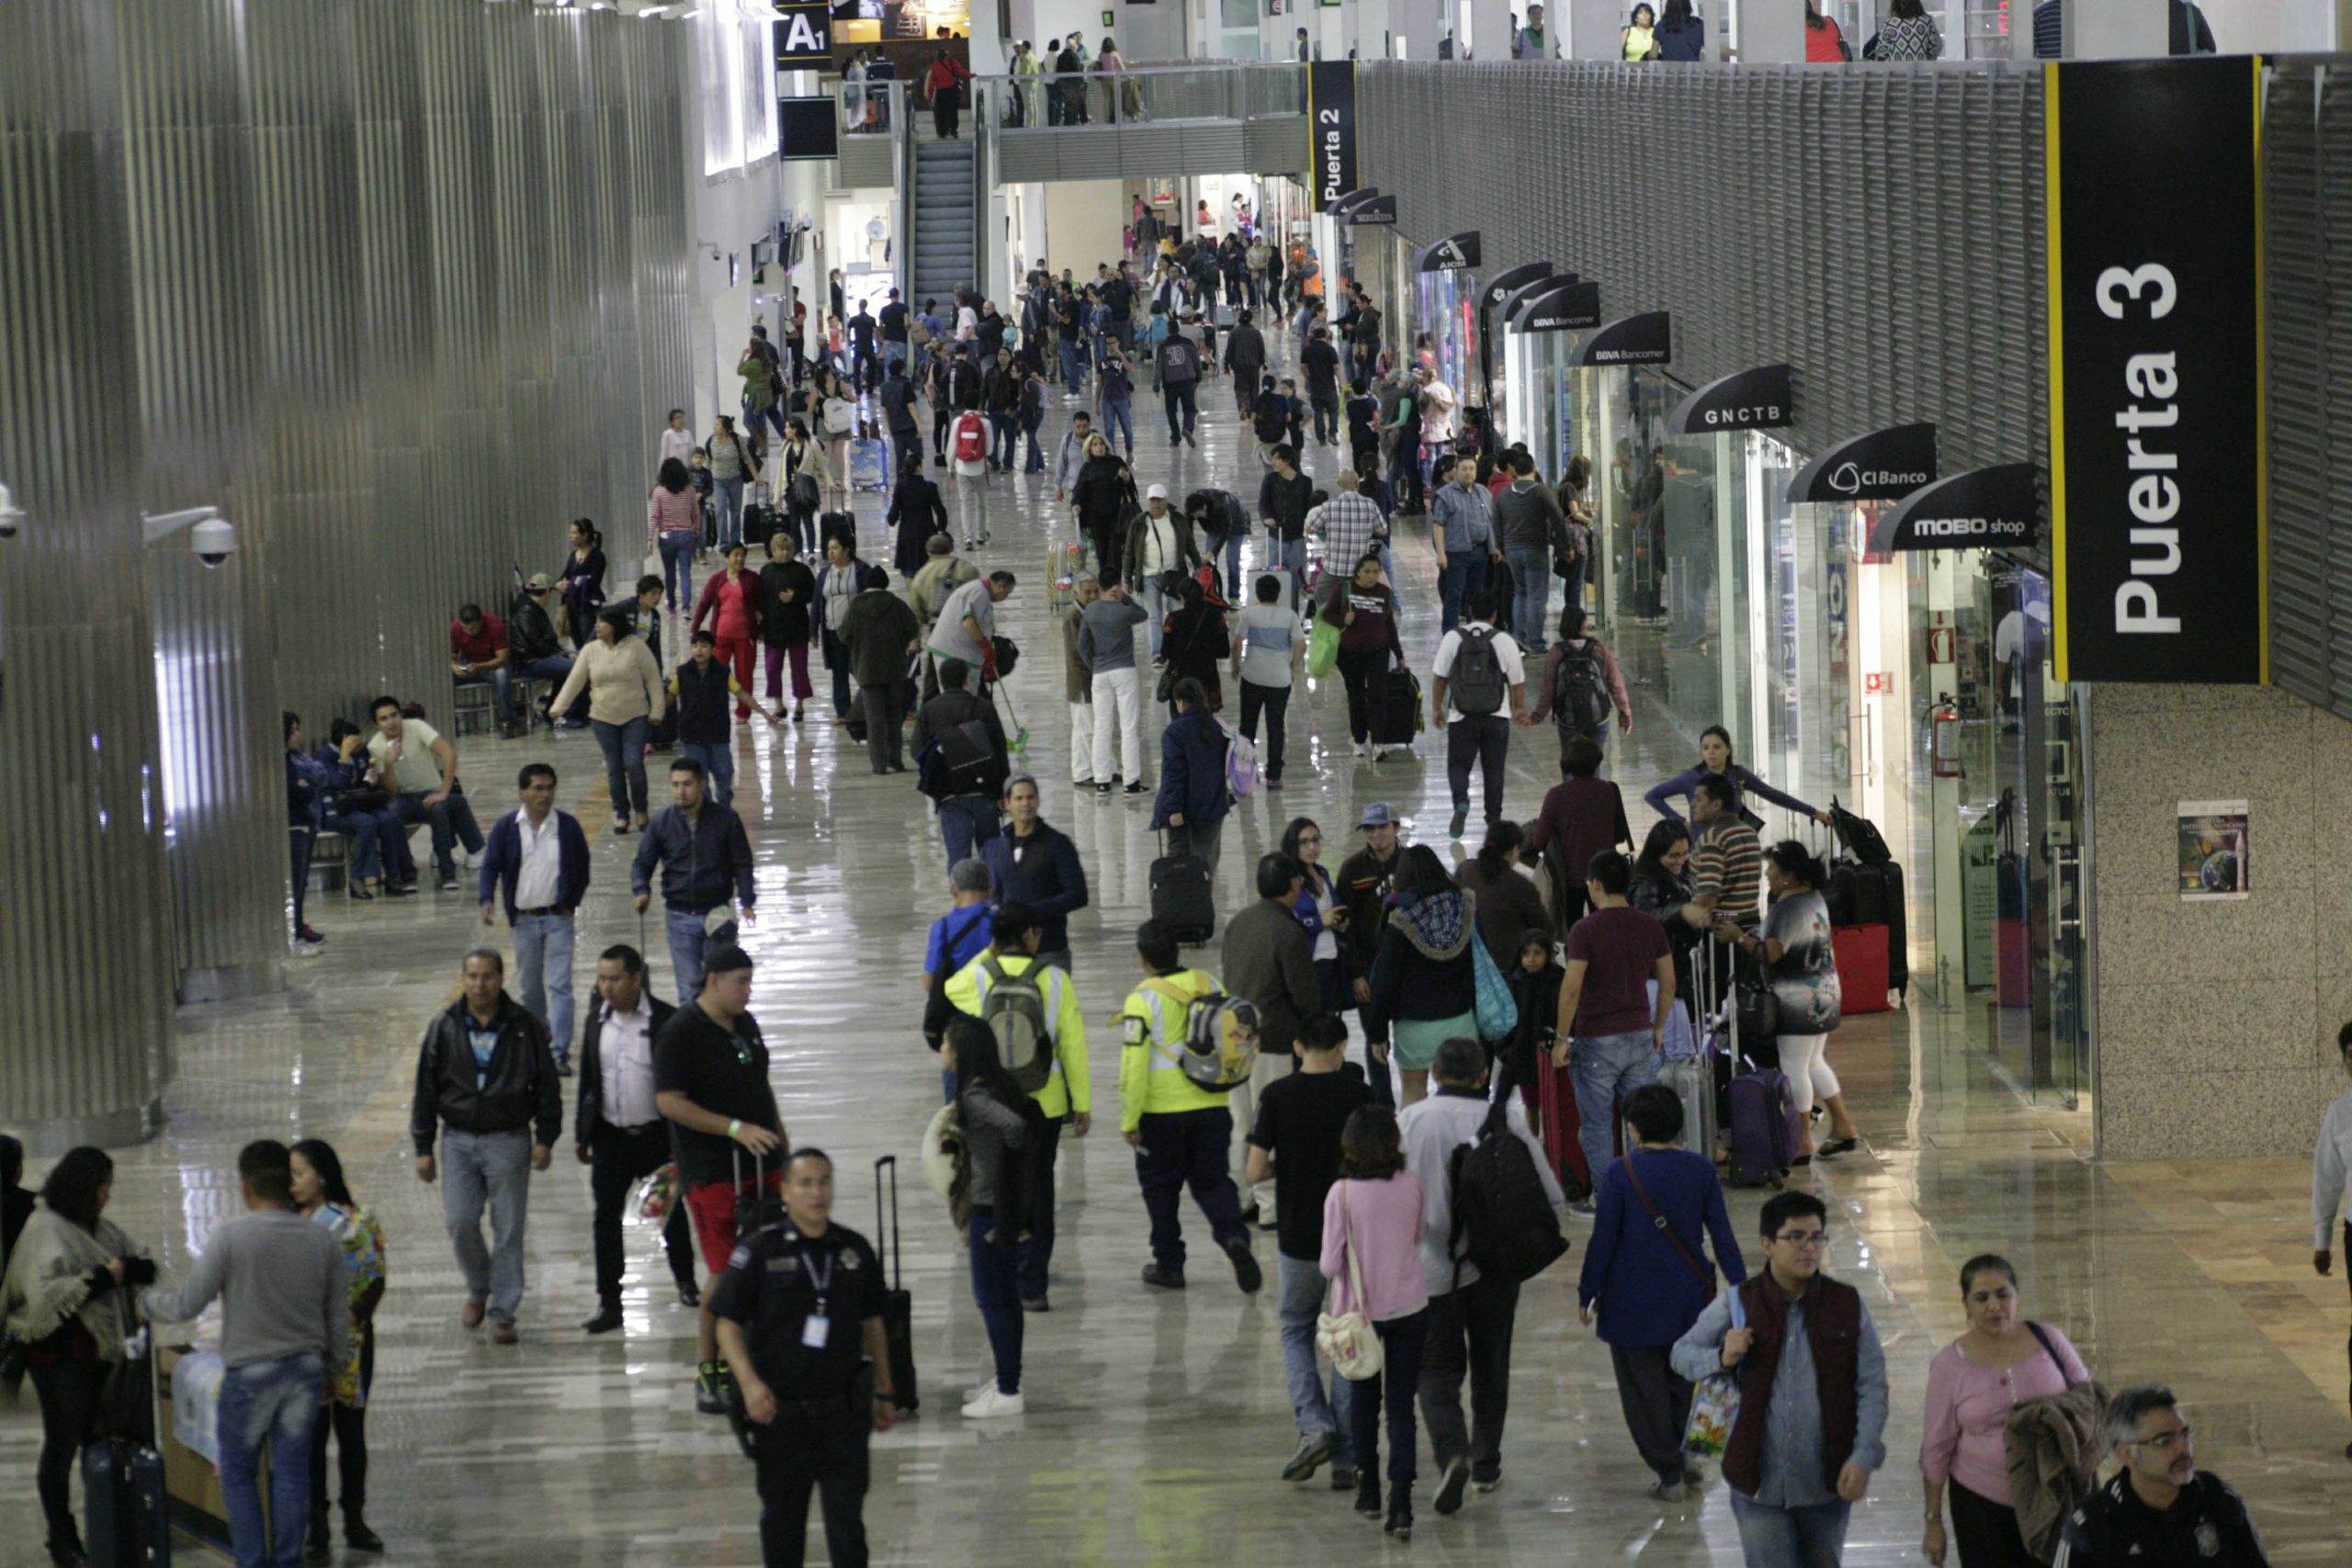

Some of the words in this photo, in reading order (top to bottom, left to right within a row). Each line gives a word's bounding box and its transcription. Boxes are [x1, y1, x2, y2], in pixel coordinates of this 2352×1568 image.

[1319, 108, 1340, 124] 2
[1324, 130, 1341, 201] Puerta
[2095, 262, 2177, 320] 3
[1533, 317, 1555, 328] BBVA
[1555, 315, 1595, 326] Bancomer
[1596, 350, 1621, 361] BBVA
[1621, 349, 1665, 360] Bancomer
[1704, 405, 1781, 424] GNCTB
[2114, 350, 2182, 634] Puerta
[1990, 519, 2025, 537] shop
